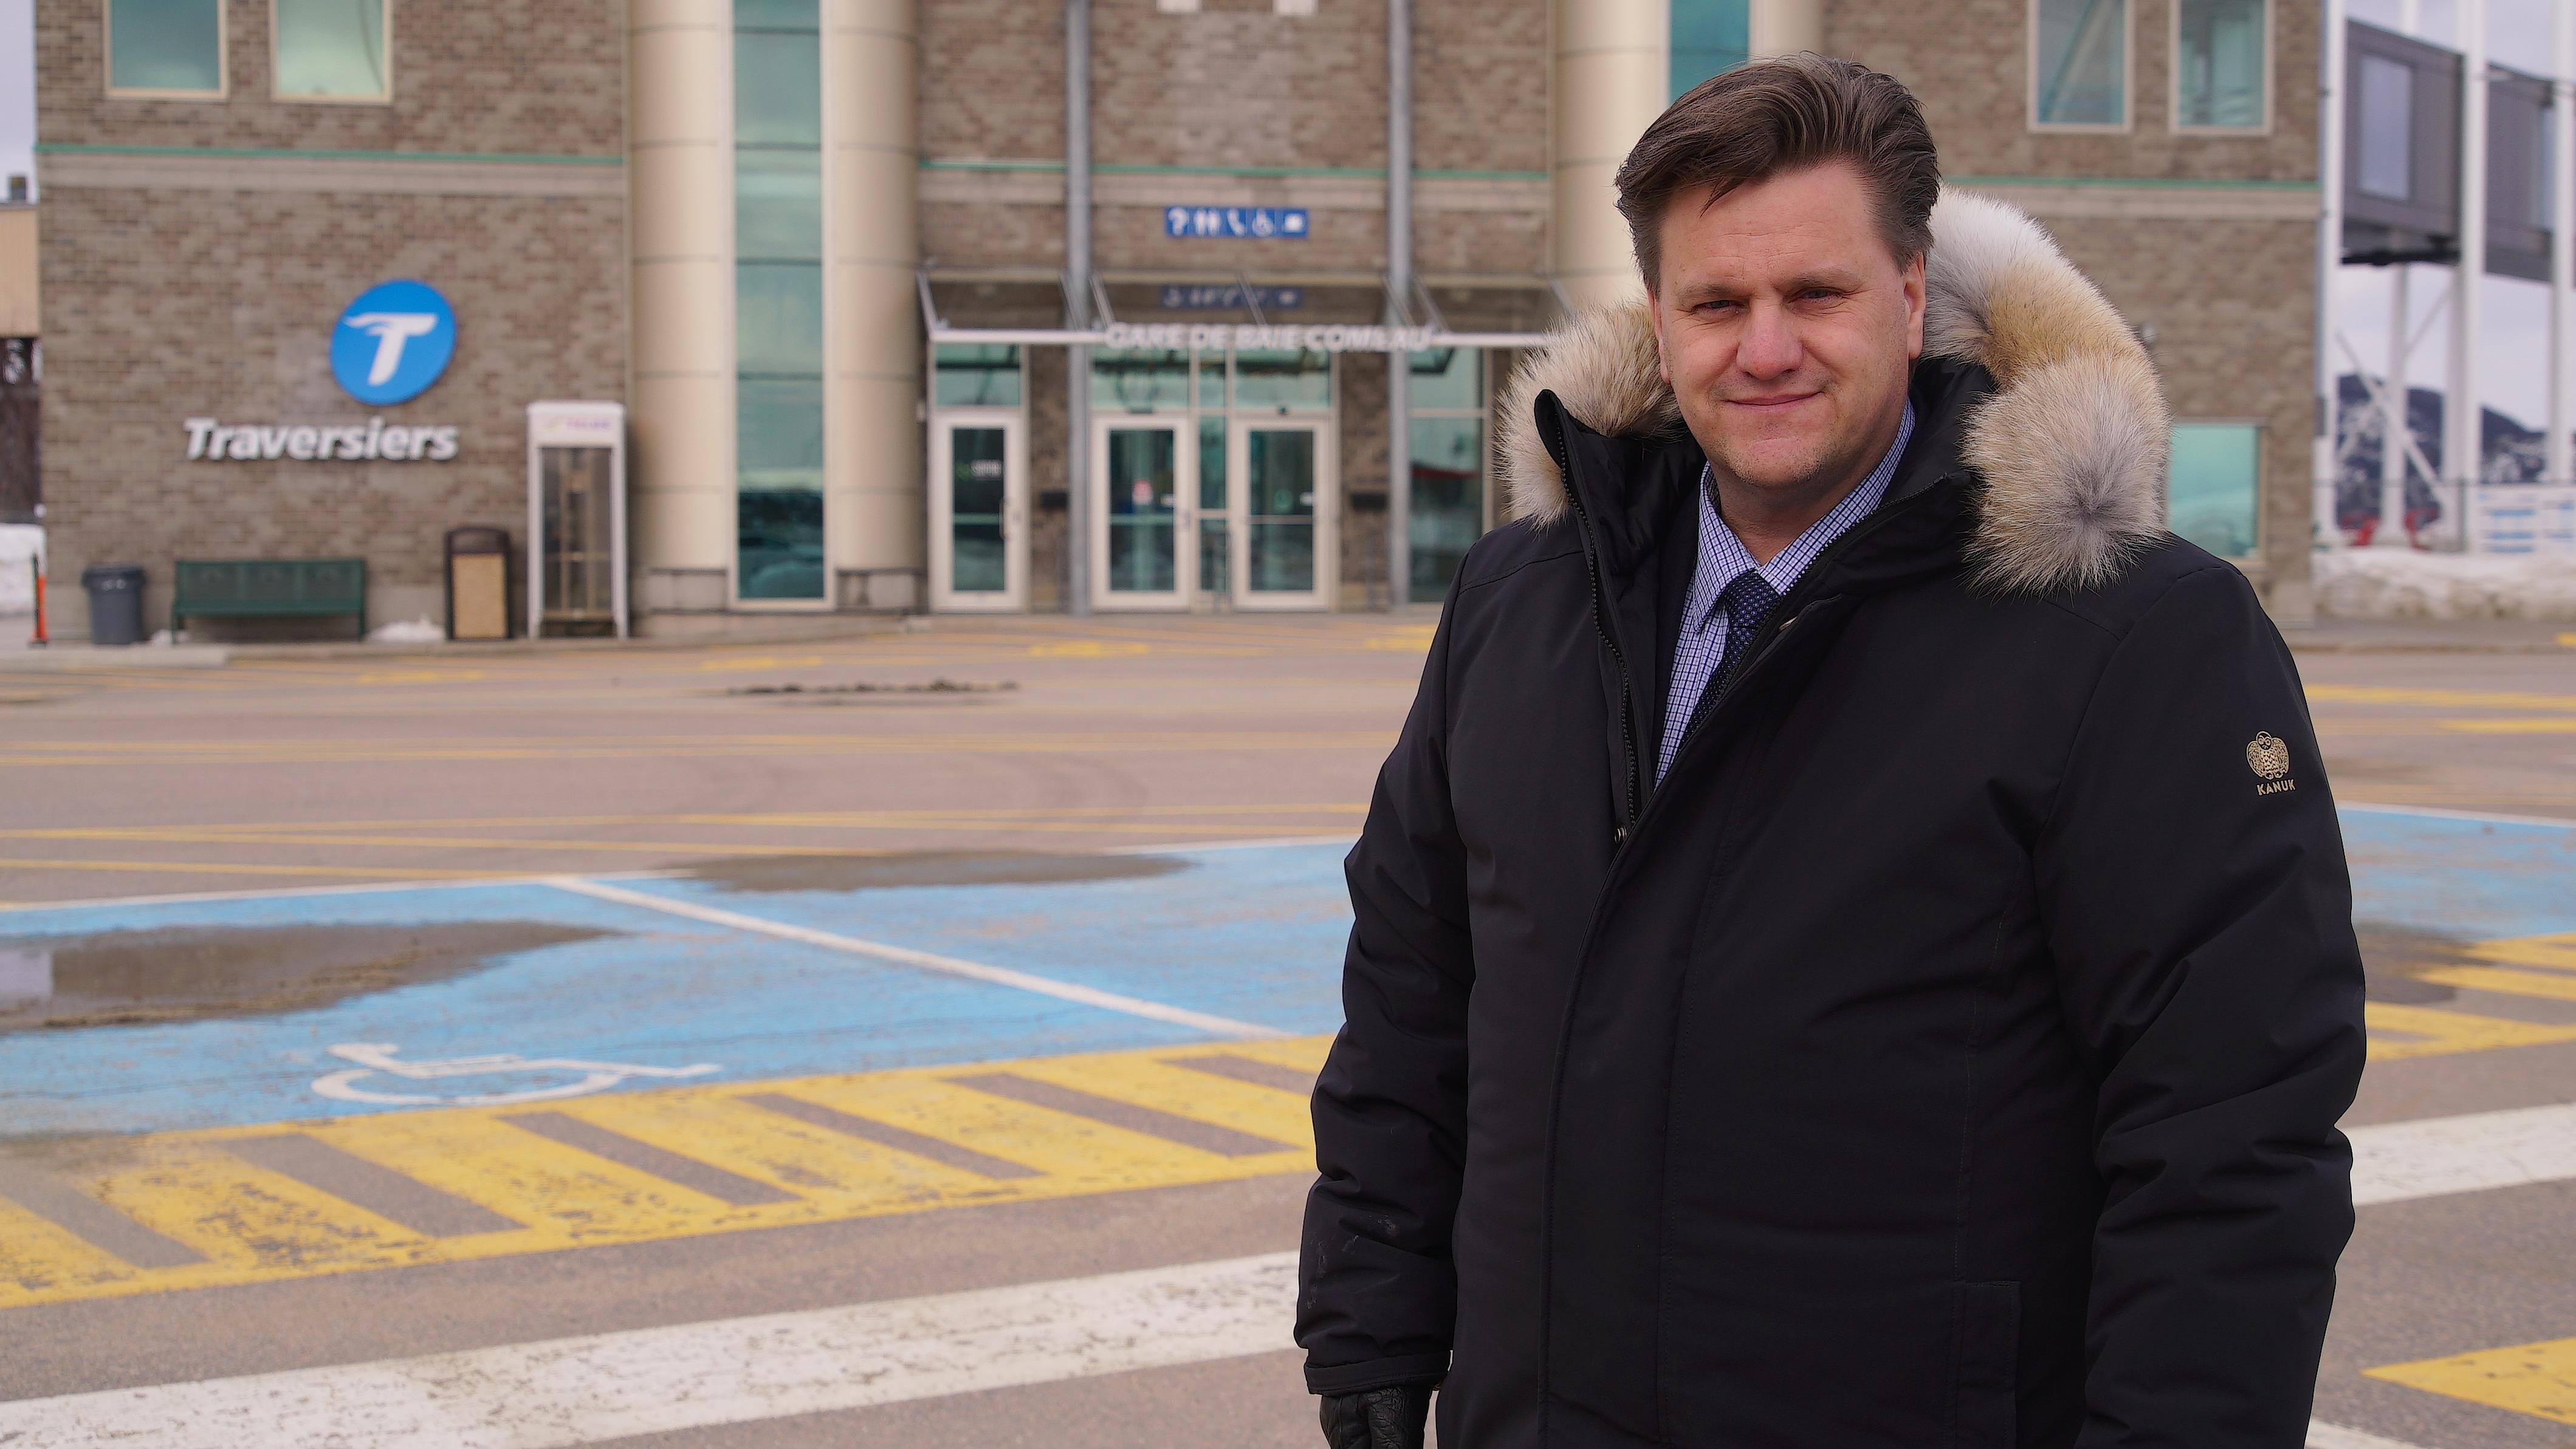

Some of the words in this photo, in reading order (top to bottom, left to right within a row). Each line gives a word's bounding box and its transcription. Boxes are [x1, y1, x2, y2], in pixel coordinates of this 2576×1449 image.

[1105, 323, 1186, 349] GARE
[1189, 323, 1230, 351] DE
[185, 416, 459, 460] Traversiers
[2256, 779, 2295, 795] KANUK
